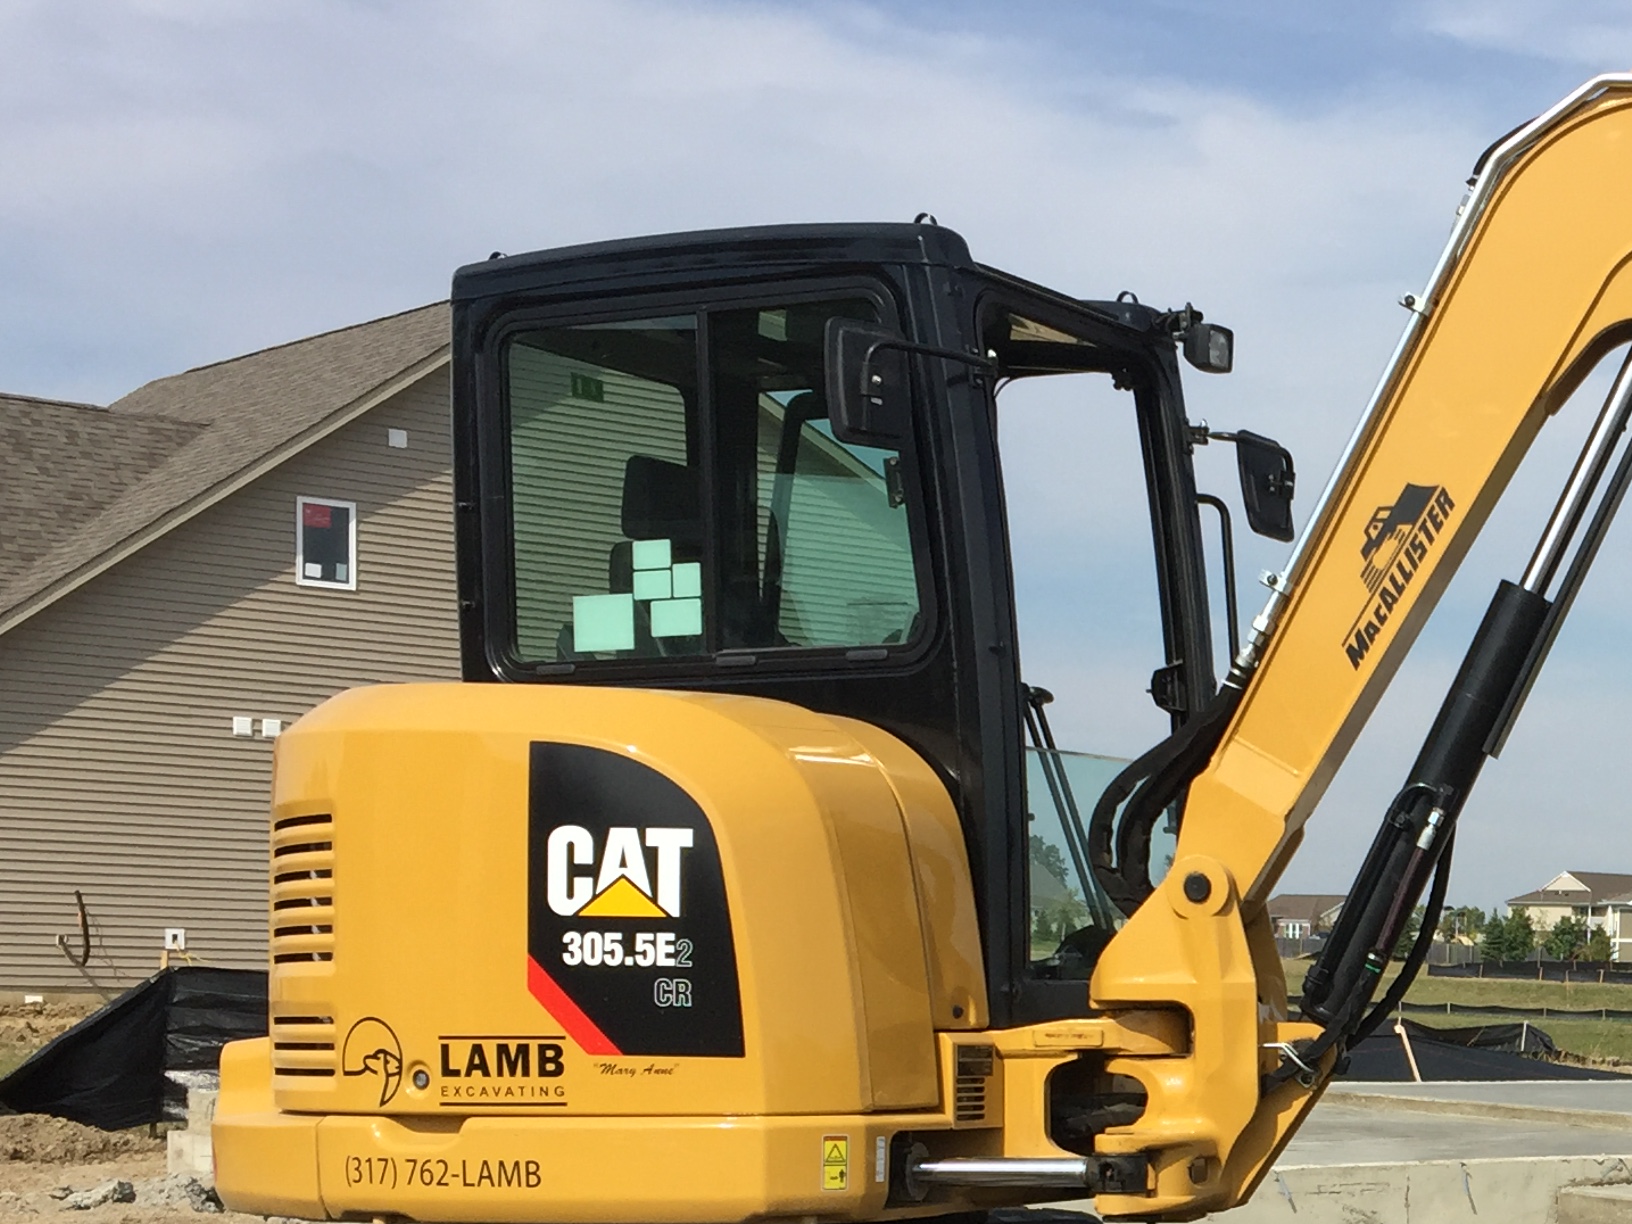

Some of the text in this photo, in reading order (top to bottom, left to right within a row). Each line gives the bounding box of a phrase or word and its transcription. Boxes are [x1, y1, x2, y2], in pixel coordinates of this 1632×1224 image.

[547, 825, 694, 918] CAT
[562, 931, 693, 967] 305.5E2
[654, 978, 693, 1007] CR
[440, 1043, 565, 1078] LAMB
[441, 1085, 565, 1097] EXCAVATING
[345, 1155, 542, 1190] (317) 762-LAMB
